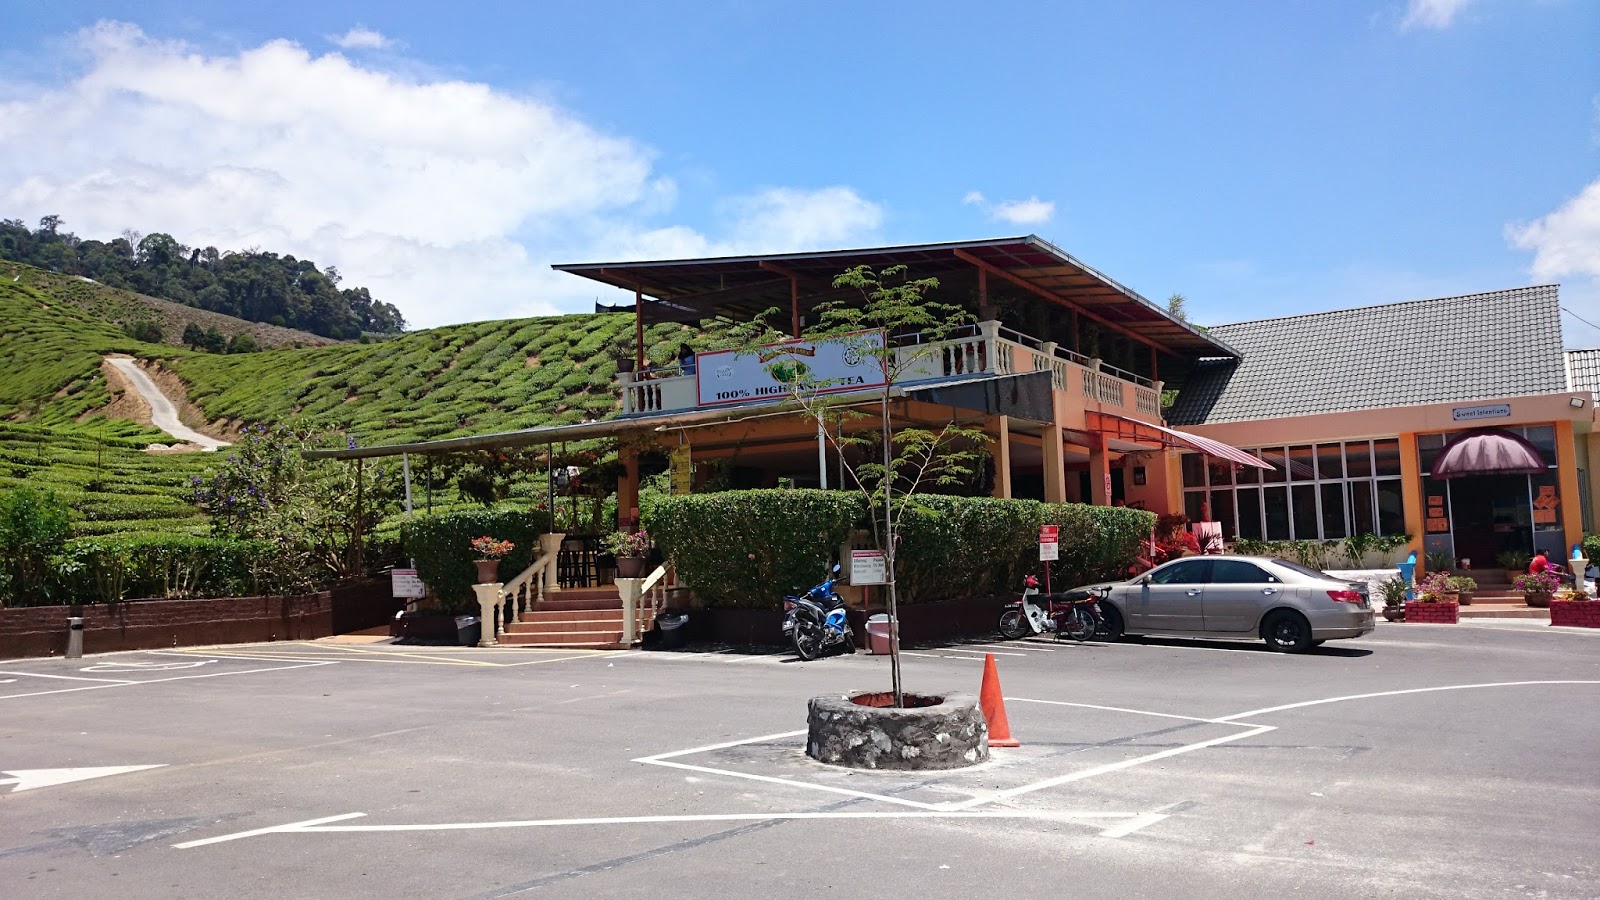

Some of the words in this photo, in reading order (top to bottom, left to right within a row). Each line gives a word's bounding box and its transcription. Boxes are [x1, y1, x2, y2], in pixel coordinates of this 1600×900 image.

[715, 389, 750, 400] 100%
[839, 375, 865, 386] TEA
[1456, 410, 1476, 418] Sweet
